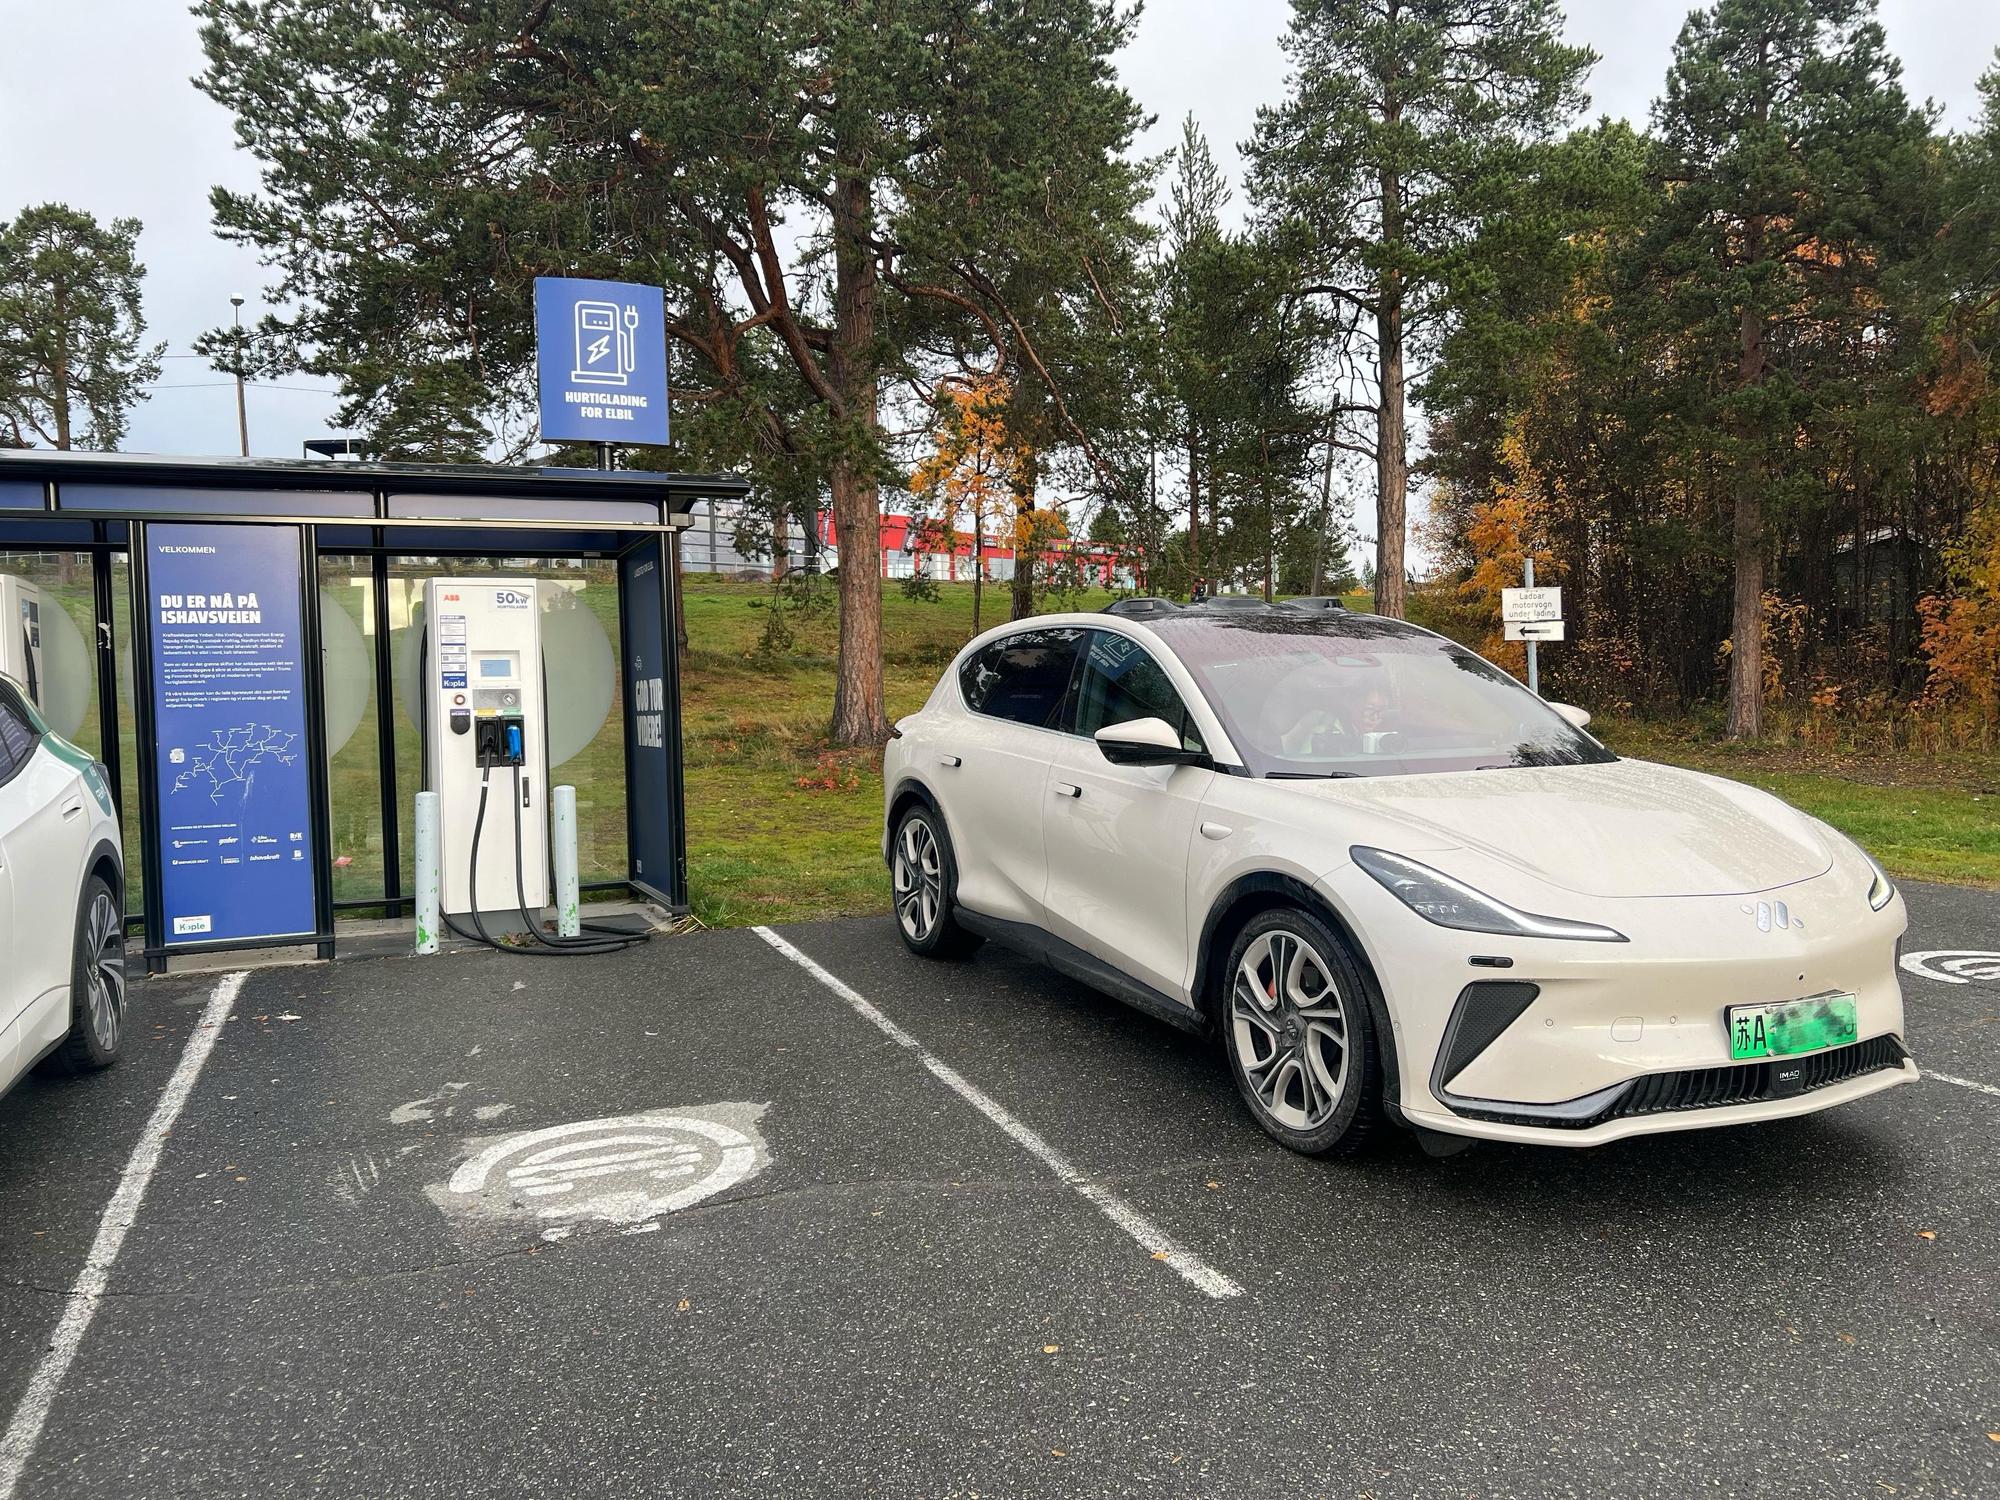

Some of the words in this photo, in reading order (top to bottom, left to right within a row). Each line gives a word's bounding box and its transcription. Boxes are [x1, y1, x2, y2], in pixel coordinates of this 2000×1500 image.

[565, 392, 648, 408] HURTIGLADING
[580, 406, 602, 418] FOR
[606, 408, 634, 420] ELBIL
[160, 595, 183, 608] DU
[186, 595, 206, 608] ER
[210, 592, 234, 608] NÅ
[238, 592, 258, 608] PÅ
[161, 610, 260, 624] ISHAVSVEIEN
[1534, 610, 1556, 618] lading
